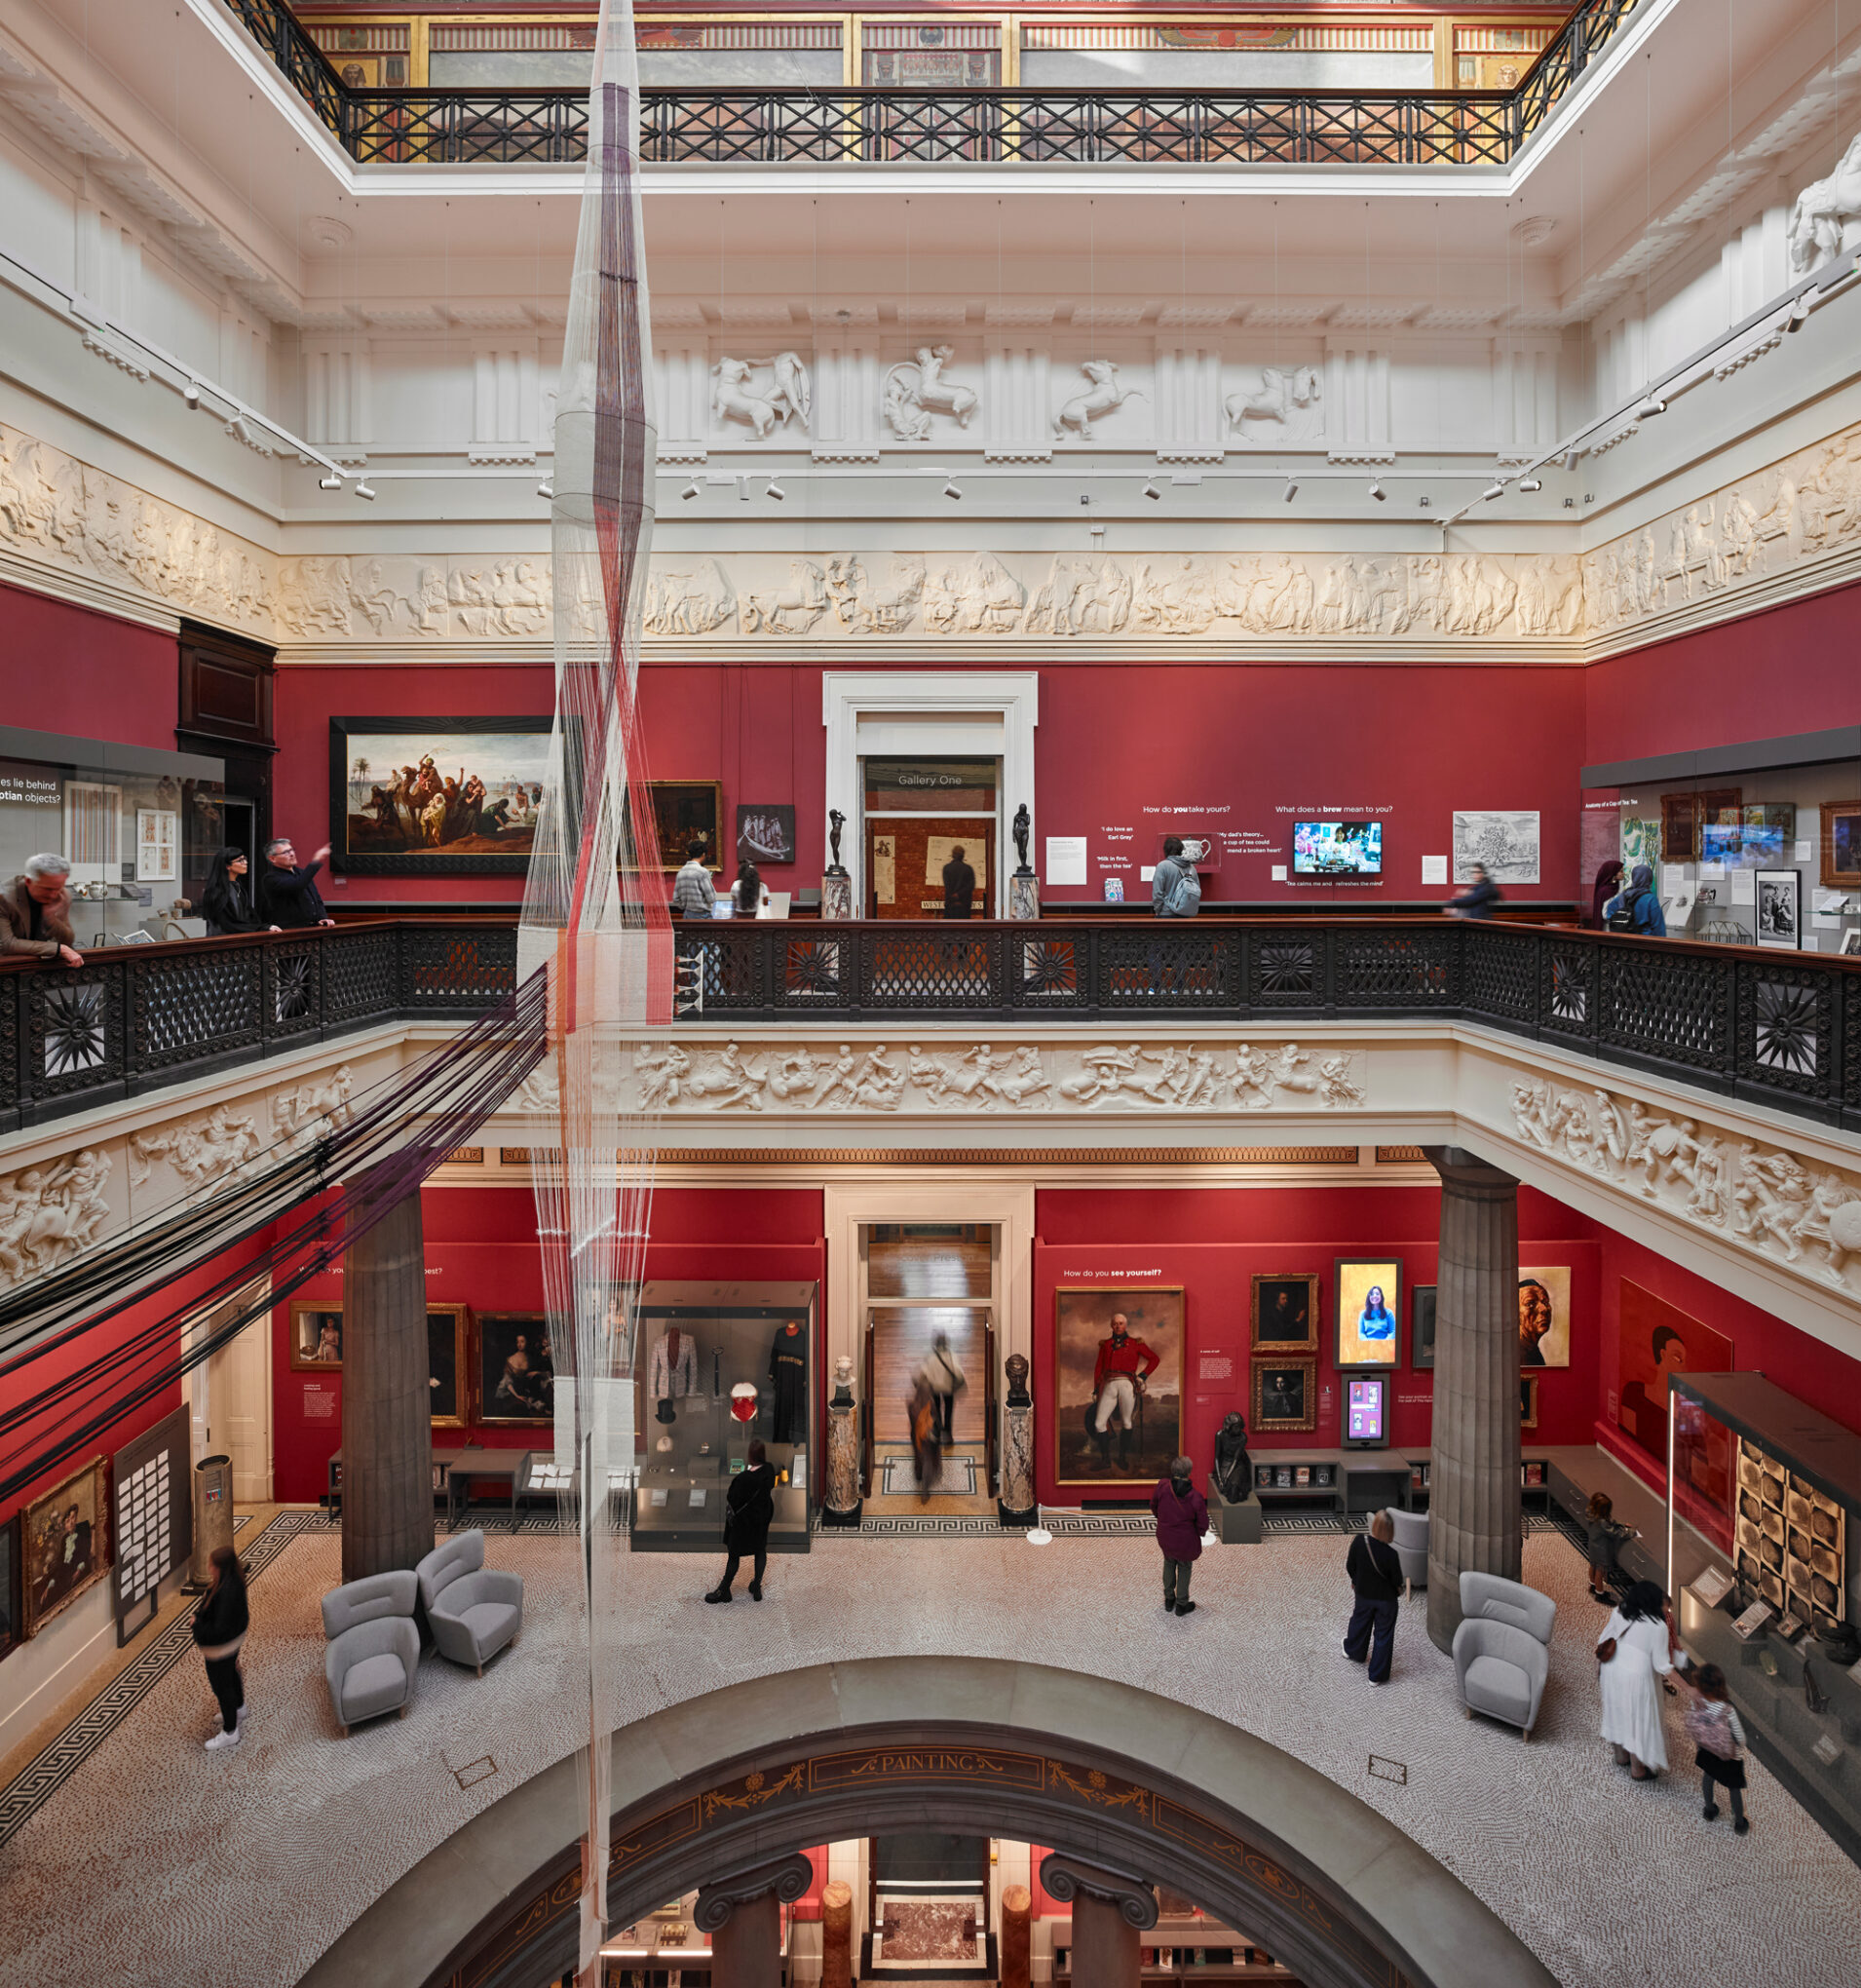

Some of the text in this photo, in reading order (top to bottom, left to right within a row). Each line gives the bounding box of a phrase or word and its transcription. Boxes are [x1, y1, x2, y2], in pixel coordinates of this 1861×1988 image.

[13, 778, 24, 788] lie
[25, 779, 57, 791] behind
[898, 775, 963, 786] Gallery One
[24, 792, 61, 805] objects?
[1206, 806, 1231, 815] yours?
[1375, 805, 1393, 814] you?
[1126, 1269, 1161, 1278] yourself?
[882, 1754, 973, 1772] PAINTING
